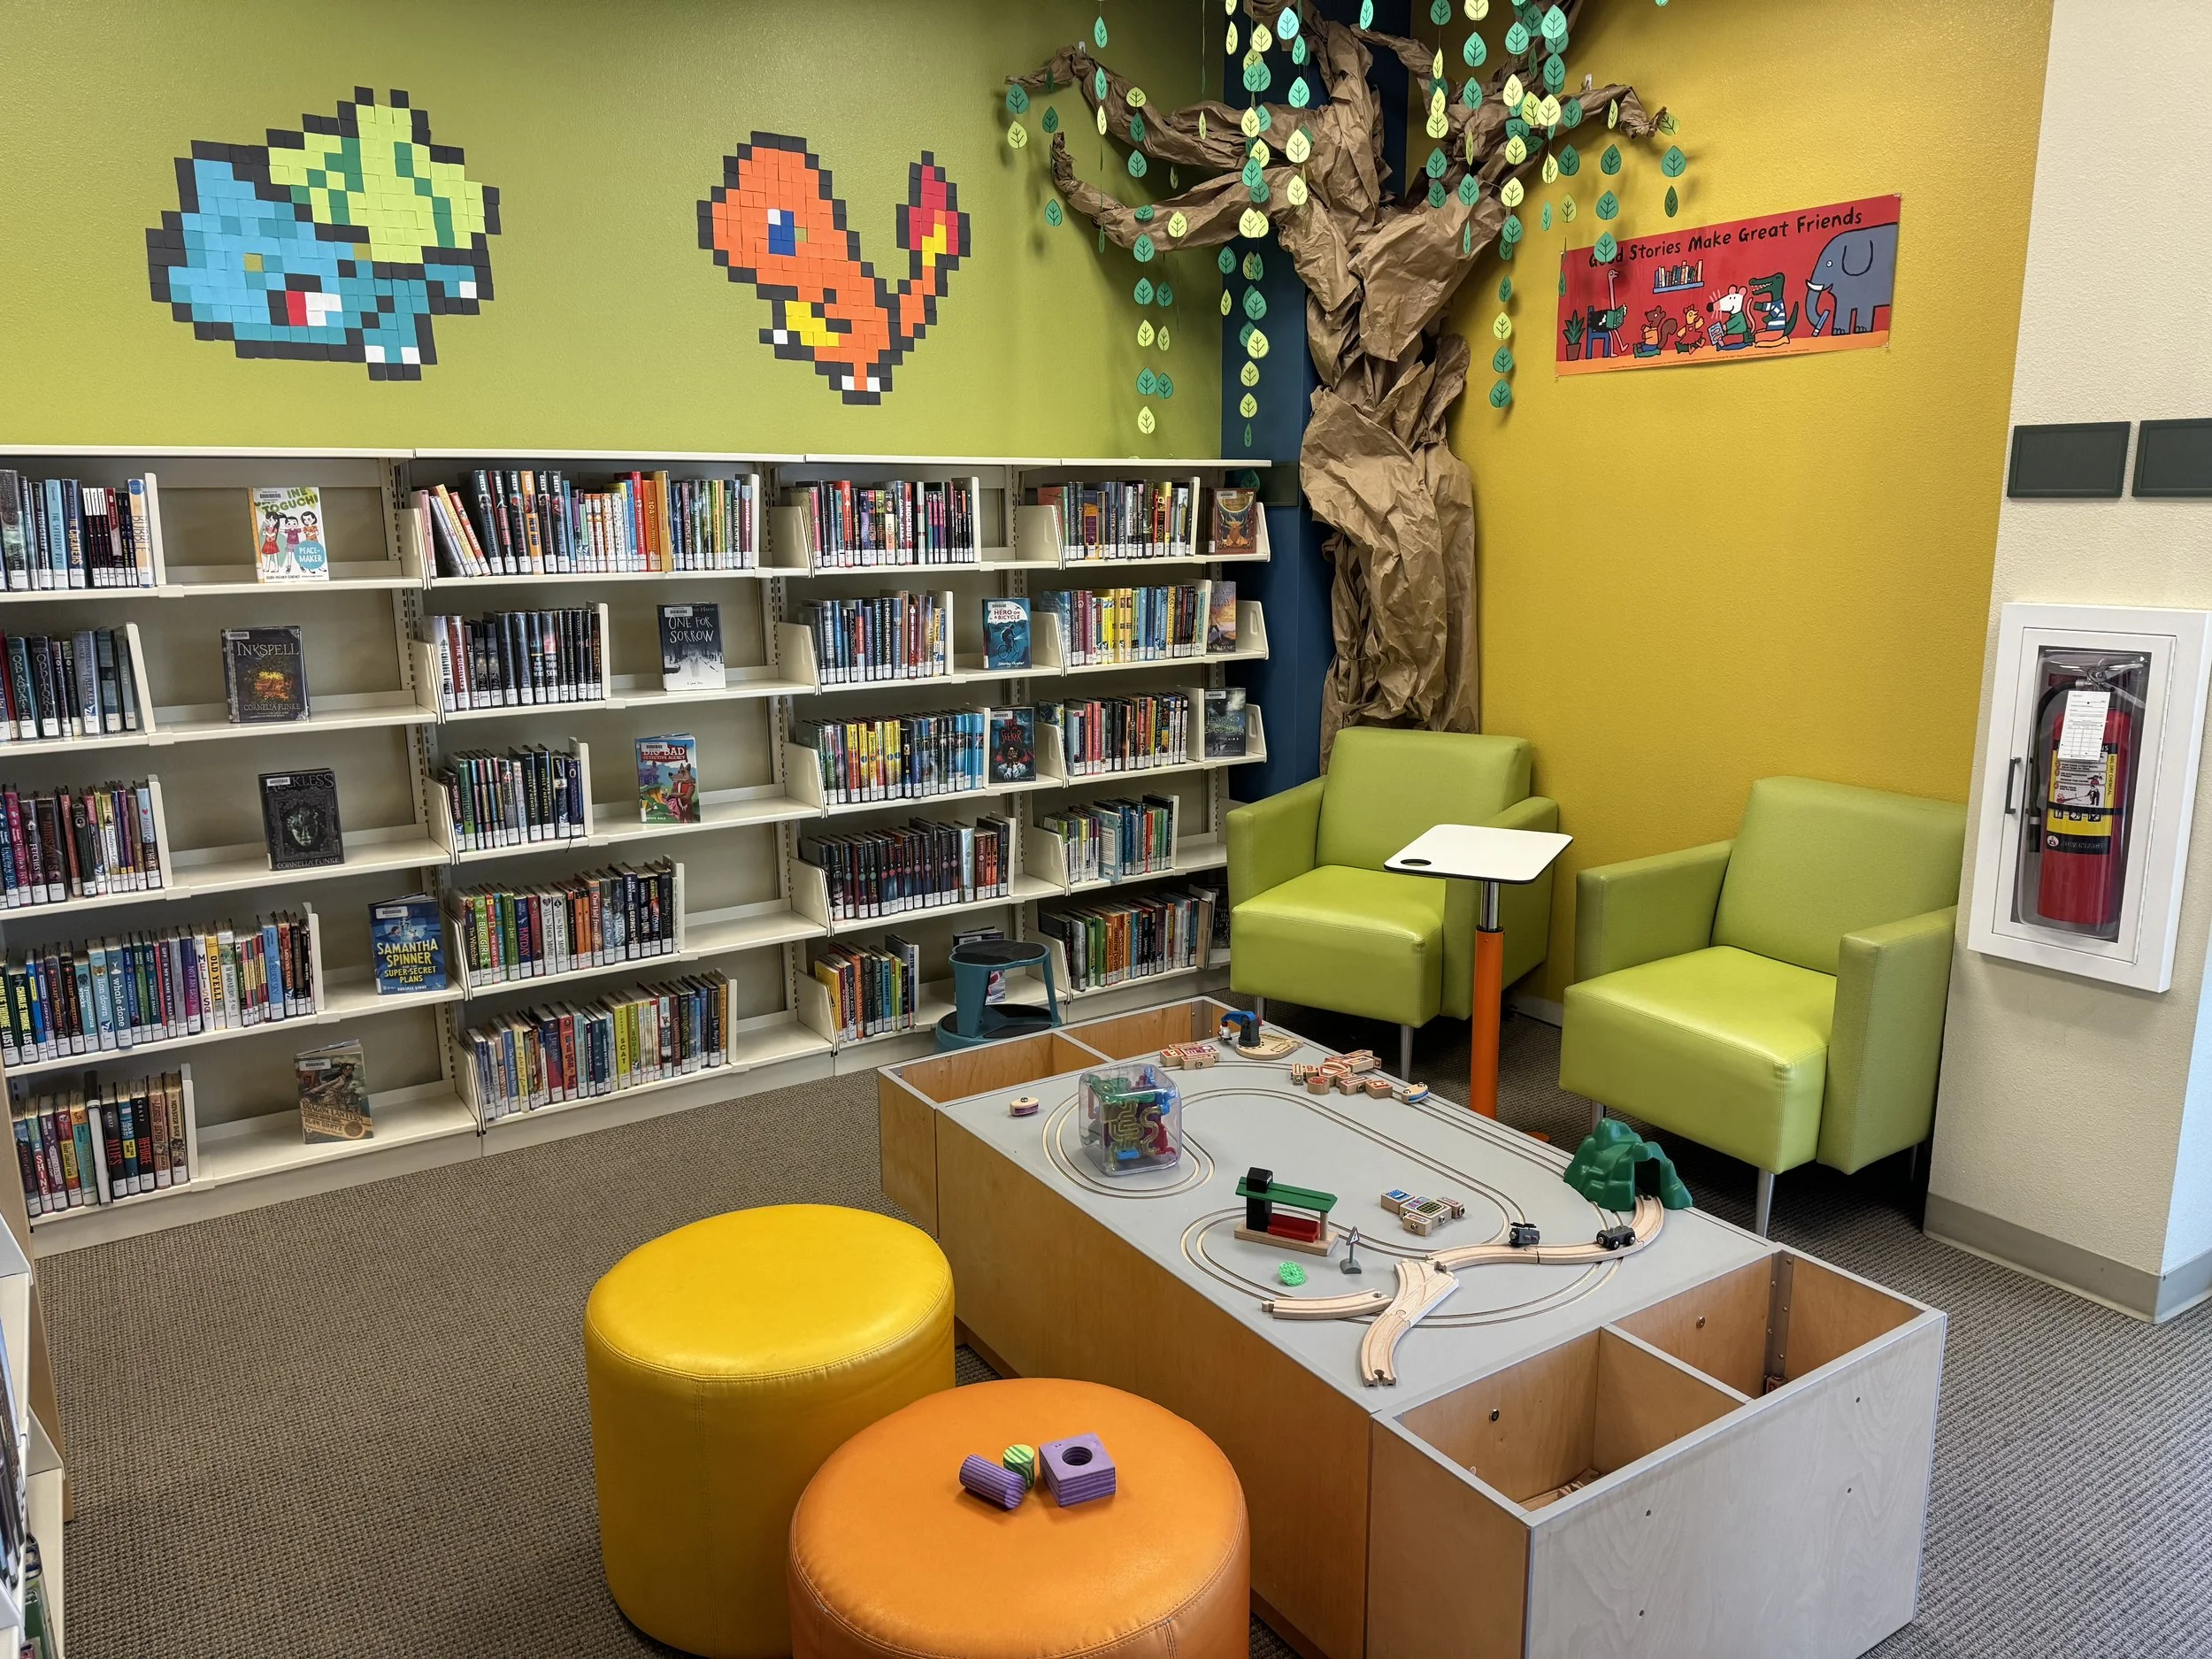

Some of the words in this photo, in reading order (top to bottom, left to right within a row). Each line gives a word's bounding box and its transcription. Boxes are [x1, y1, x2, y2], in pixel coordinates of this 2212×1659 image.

[1629, 242, 1681, 261] Stories
[1687, 230, 1732, 252] Make
[1738, 221, 1788, 243] Great
[1797, 206, 1862, 234] Friends
[132, 515, 150, 552] BUBBLE
[68, 529, 83, 565] CREAKERS
[669, 617, 691, 629] ONE
[695, 617, 713, 627] FOR
[670, 631, 714, 643] SORROW
[236, 641, 299, 658] INKSPELL
[457, 658, 465, 689] DECEIVERS
[148, 853, 157, 871] HEART
[377, 938, 438, 955] SAMANTHA
[519, 927, 529, 956] MAYDAY
[387, 952, 432, 967] SPINNER
[164, 968, 168, 977] MY
[113, 978, 124, 1004] whale
[189, 979, 196, 987] AN
[16, 987, 27, 1009] CHARLIE
[189, 989, 198, 1002] EASY
[0, 1004, 11, 1028] THORNE
[85, 987, 95, 1028] tyrannosaurus
[117, 1006, 126, 1026] done
[20, 1010, 30, 1030] THORNE
[2, 1031, 13, 1047] LOST
[303, 1102, 329, 1114] DRAGON
[107, 1139, 122, 1165] ALLIES
[138, 1137, 151, 1165] REFUGEE
[36, 1156, 48, 1194] SHINE
